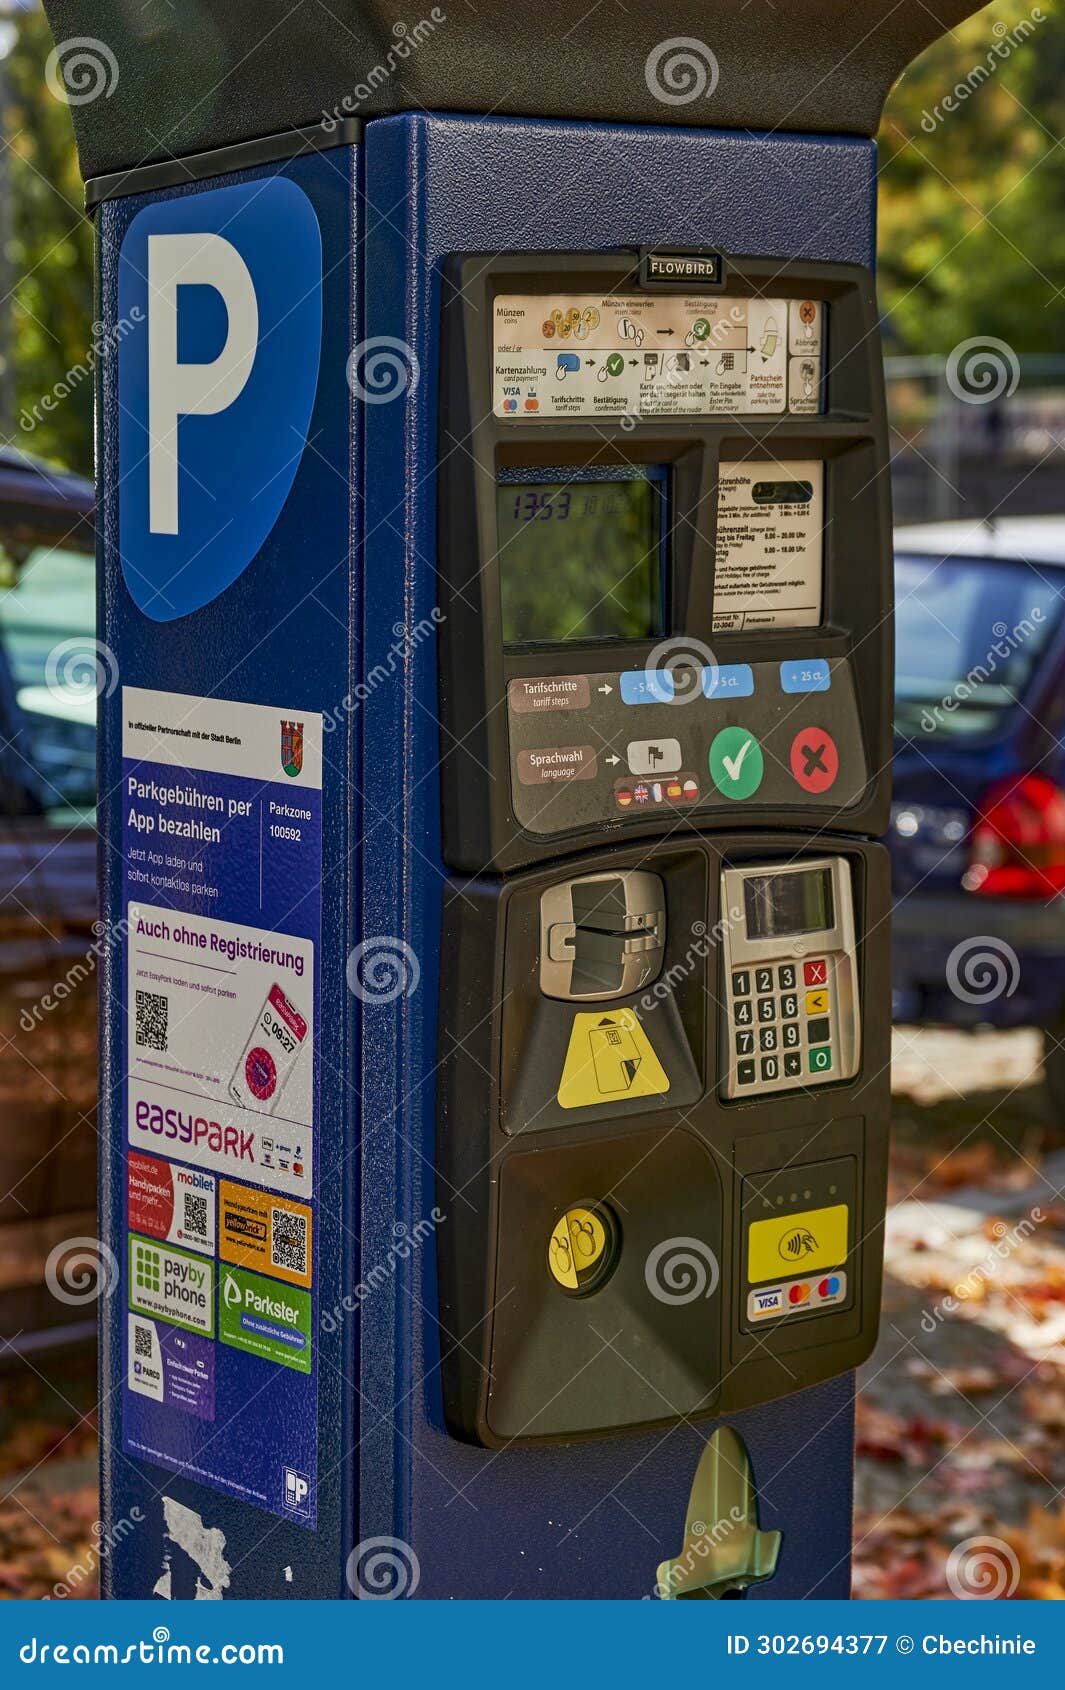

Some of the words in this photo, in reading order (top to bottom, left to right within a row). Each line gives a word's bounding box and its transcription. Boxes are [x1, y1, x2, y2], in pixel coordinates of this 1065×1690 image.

[651, 261, 715, 276] FLOWBIRD
[496, 307, 525, 318] Münzen
[503, 317, 518, 325] coins
[495, 365, 547, 377] Kartenzahlung
[518, 375, 539, 383] payment
[147, 232, 259, 535] P
[502, 387, 521, 396] VISA
[719, 382, 742, 391] Eingabe
[550, 395, 585, 404] Tarifschritte
[567, 403, 581, 412] steps
[592, 396, 629, 406] Bestätigung
[594, 403, 627, 412] confirmation
[736, 533, 755, 542] Freitag
[796, 545, 807, 553] Uhr
[523, 680, 578, 695] Tarifschritte
[727, 677, 740, 687] ct.
[801, 671, 812, 682] 25
[533, 696, 551, 708] tariff
[551, 696, 569, 707] steps
[128, 721, 134, 729] In
[134, 721, 157, 733] offizieller
[191, 731, 200, 739] mit
[201, 732, 210, 741] der
[210, 734, 225, 743] Stadt
[225, 735, 241, 745] Berlin
[529, 750, 583, 767] Sprachwahl
[541, 767, 575, 779] language
[128, 777, 224, 812] Parkgebühren
[228, 798, 252, 817] per
[269, 801, 312, 821] Parkzone
[127, 807, 155, 834] App
[158, 813, 221, 843] bezahlen
[269, 825, 301, 842] 100592
[127, 847, 146, 861] Jetzt
[147, 851, 163, 865] App
[165, 854, 185, 869] laden
[188, 859, 203, 872] und
[127, 869, 149, 884] sofort
[150, 875, 190, 892] kontaktlos
[191, 882, 219, 898] parken
[136, 918, 170, 940] Auch
[172, 925, 207, 948] ohne
[210, 933, 304, 977] Registrierung
[737, 975, 745, 993] 1
[760, 972, 770, 990] 2
[783, 969, 793, 986] 3
[172, 977, 188, 988] laden
[188, 982, 200, 991] und
[200, 983, 217, 995] sofort
[217, 989, 237, 1000] parken
[738, 1004, 748, 1021] 4
[763, 1001, 772, 1019] 5
[785, 997, 795, 1015] 6
[271, 1022, 295, 1054] 09:27
[740, 1033, 750, 1051] 7
[764, 1030, 774, 1048] 8
[787, 1027, 796, 1044] 9
[766, 1059, 775, 1077] 0
[129, 1175, 171, 1198] Handyparken
[177, 1171, 214, 1193] mobilet
[128, 1190, 142, 1201] und
[258, 1209, 268, 1218] mit
[164, 1258, 205, 1289] payby
[164, 1280, 206, 1308] phone
[758, 1295, 779, 1309] VISA
[136, 1296, 206, 1327] www.paybyphone.com
[245, 1288, 300, 1324] Parkster
[242, 1317, 255, 1328] Ohne
[142, 1366, 161, 1380] PARCO
